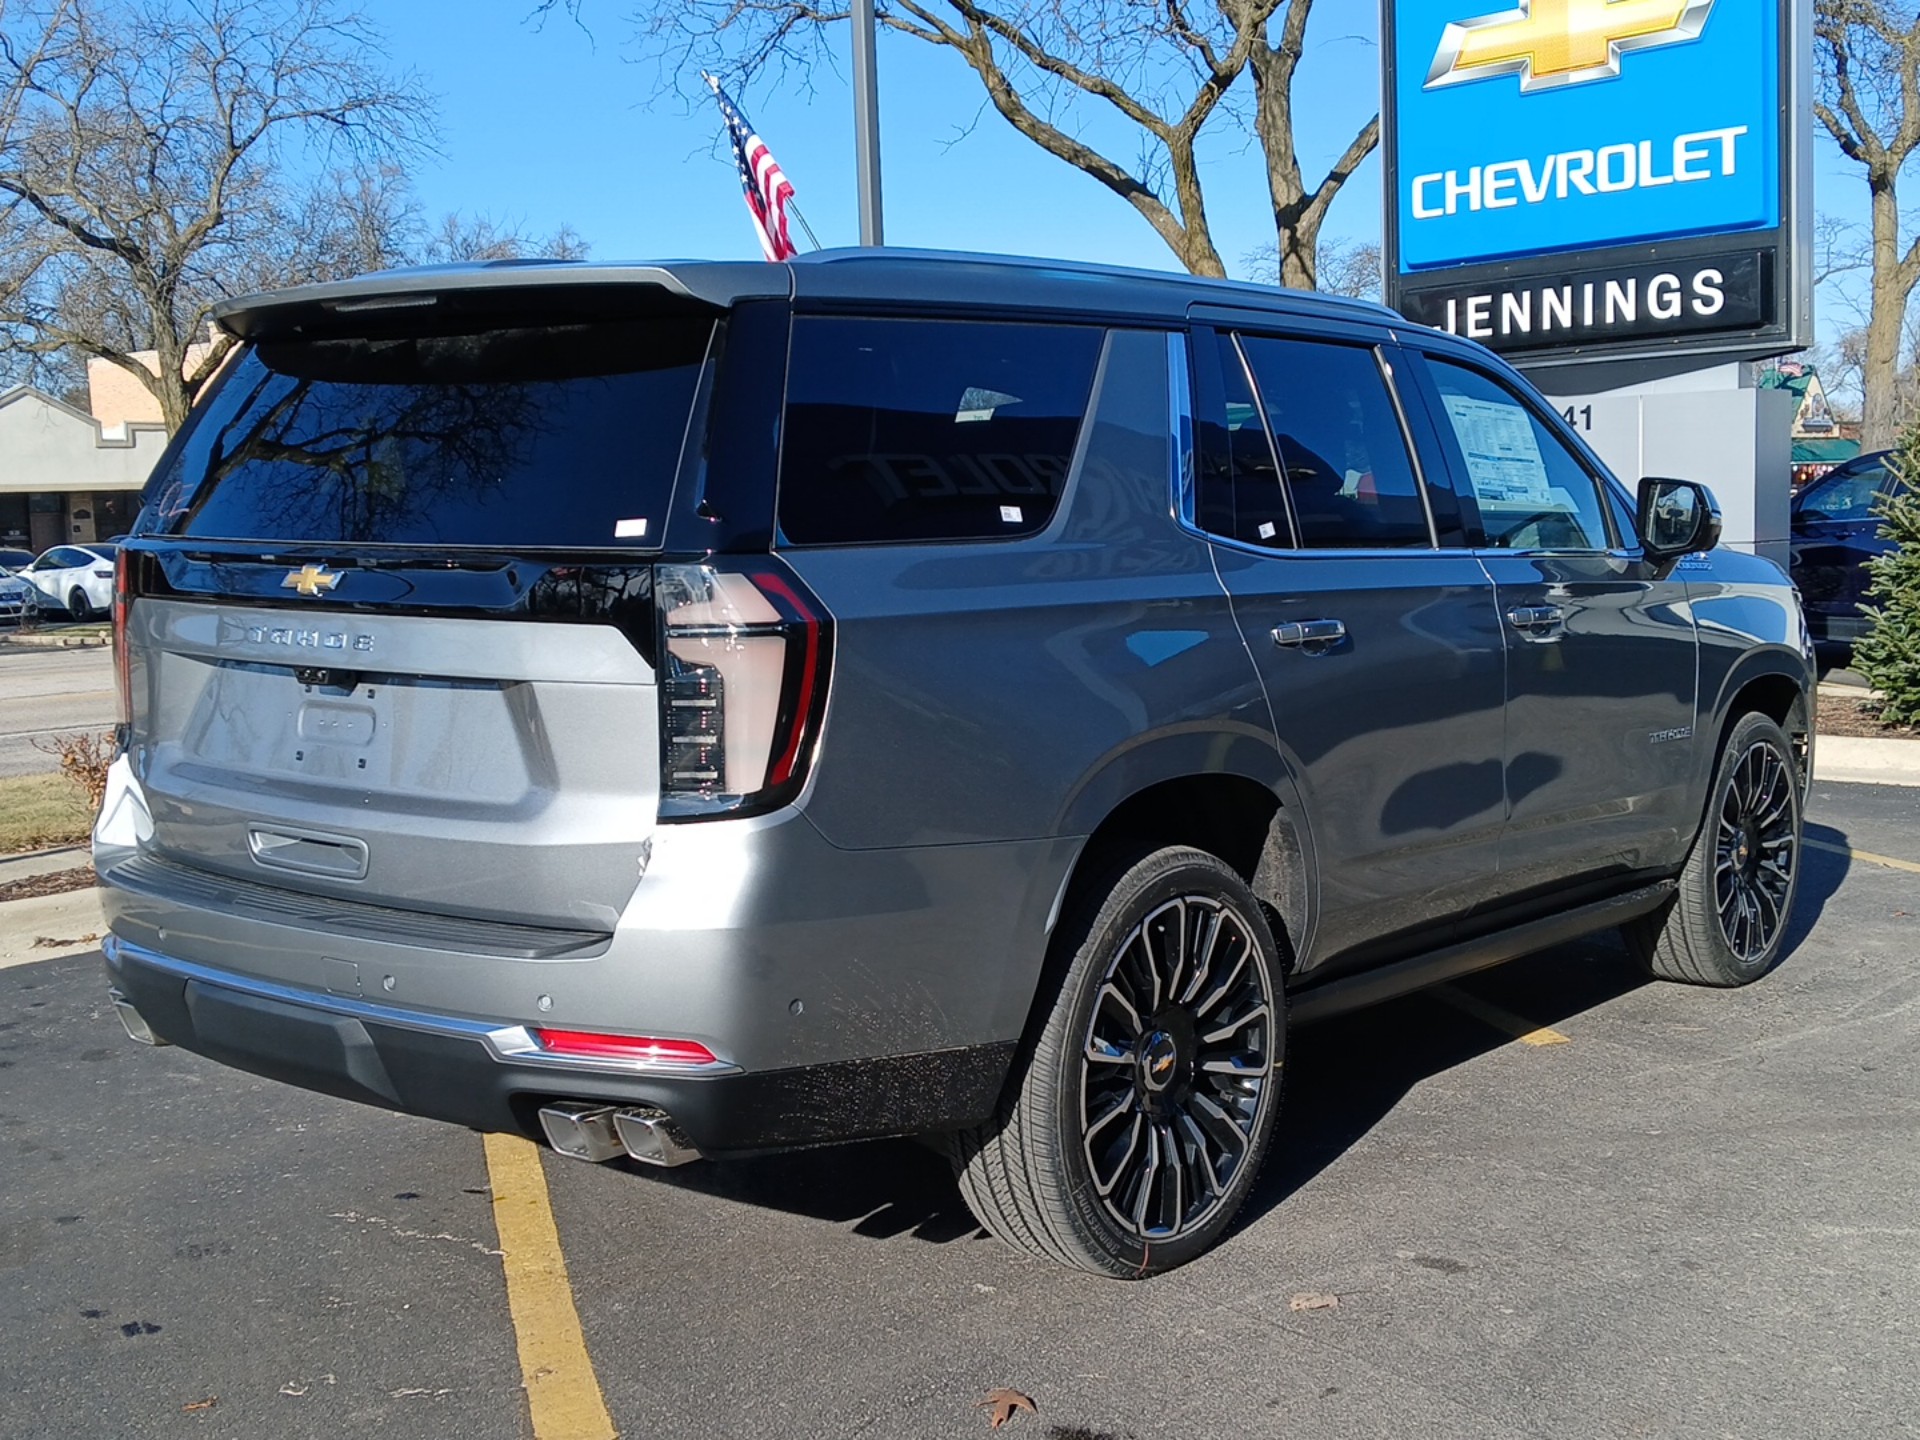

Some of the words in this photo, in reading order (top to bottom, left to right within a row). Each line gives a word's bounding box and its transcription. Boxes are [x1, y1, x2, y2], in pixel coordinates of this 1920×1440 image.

[1411, 125, 1748, 220] CHEVROLET
[1431, 268, 1726, 338] JENNINGS
[250, 626, 376, 652] TAHOE
